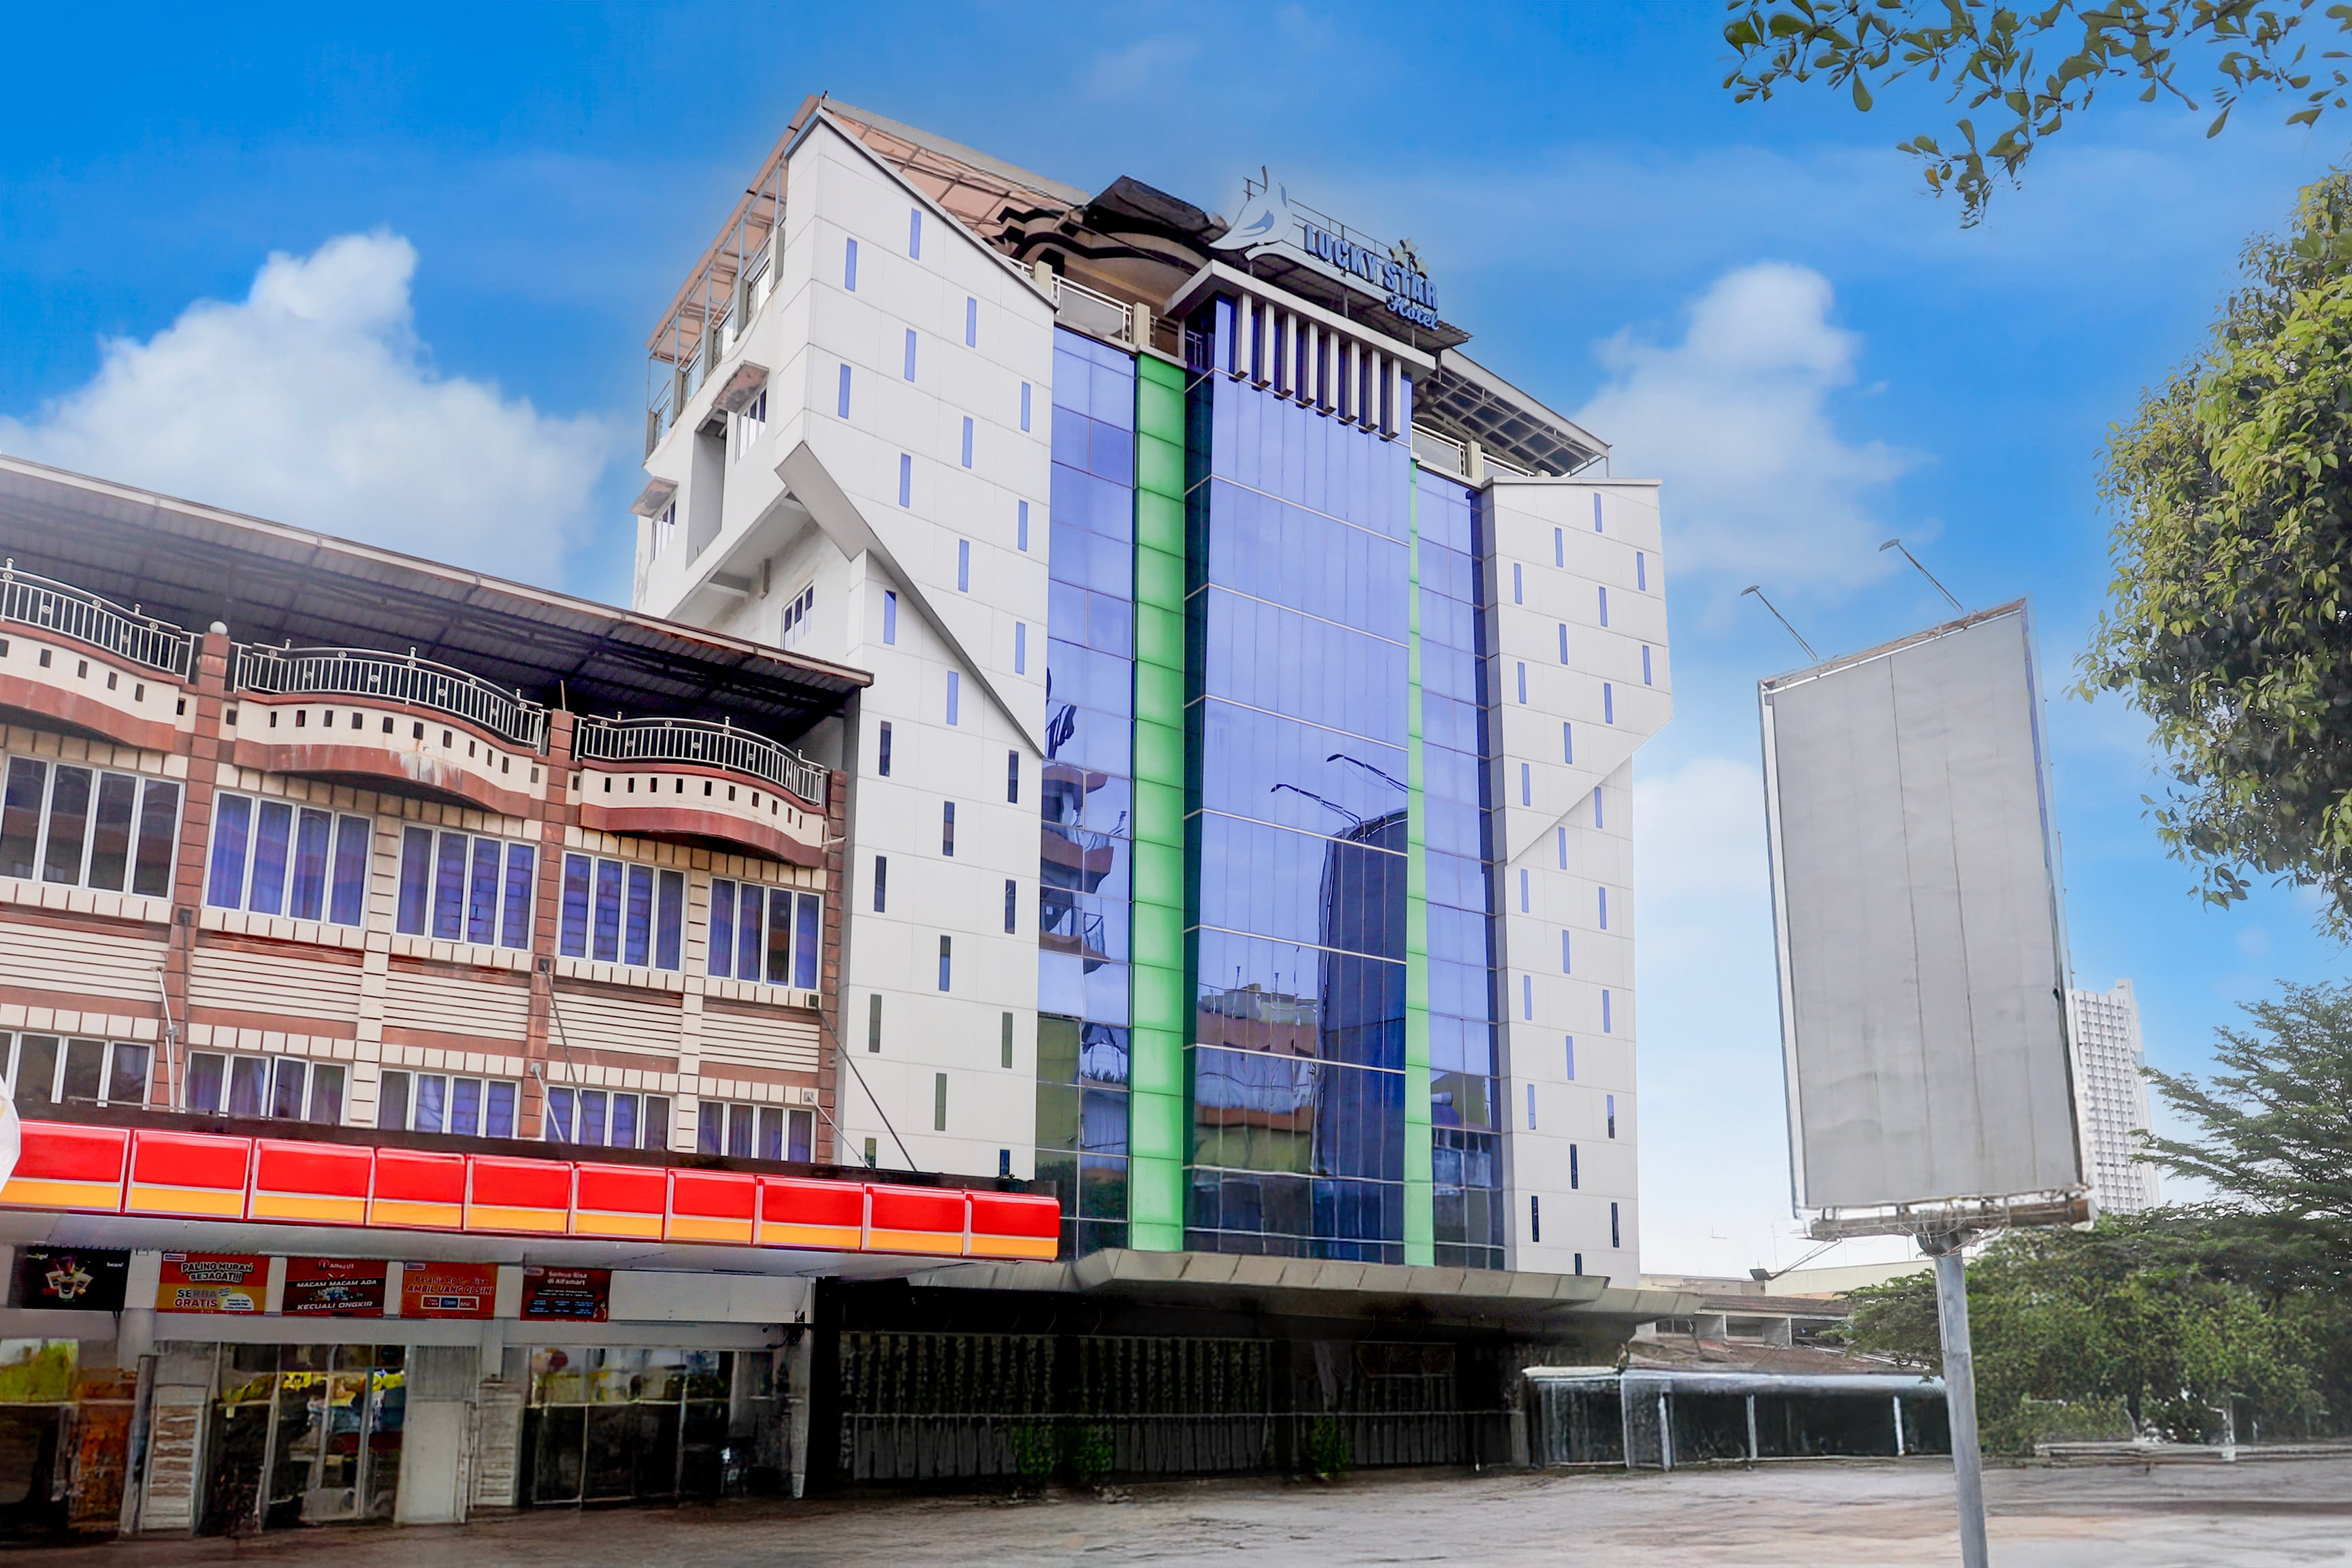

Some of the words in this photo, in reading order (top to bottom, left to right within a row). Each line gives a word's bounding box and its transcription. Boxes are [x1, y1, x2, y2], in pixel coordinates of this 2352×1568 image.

[1304, 224, 1377, 282] LUCKY
[1382, 261, 1438, 310] STAR
[1386, 293, 1439, 331] Hotel
[182, 1262, 216, 1273] PALING
[218, 1262, 254, 1273] MURAH
[189, 1272, 243, 1283] SEJAGAT!!!
[415, 1275, 444, 1284] Belanja
[446, 1277, 457, 1285] Rp
[177, 1288, 217, 1298] SERBA
[407, 1285, 435, 1293] AMBIL
[438, 1286, 463, 1294] UANG
[174, 1298, 218, 1308] GRATIS
[297, 1303, 336, 1311] KECUALI
